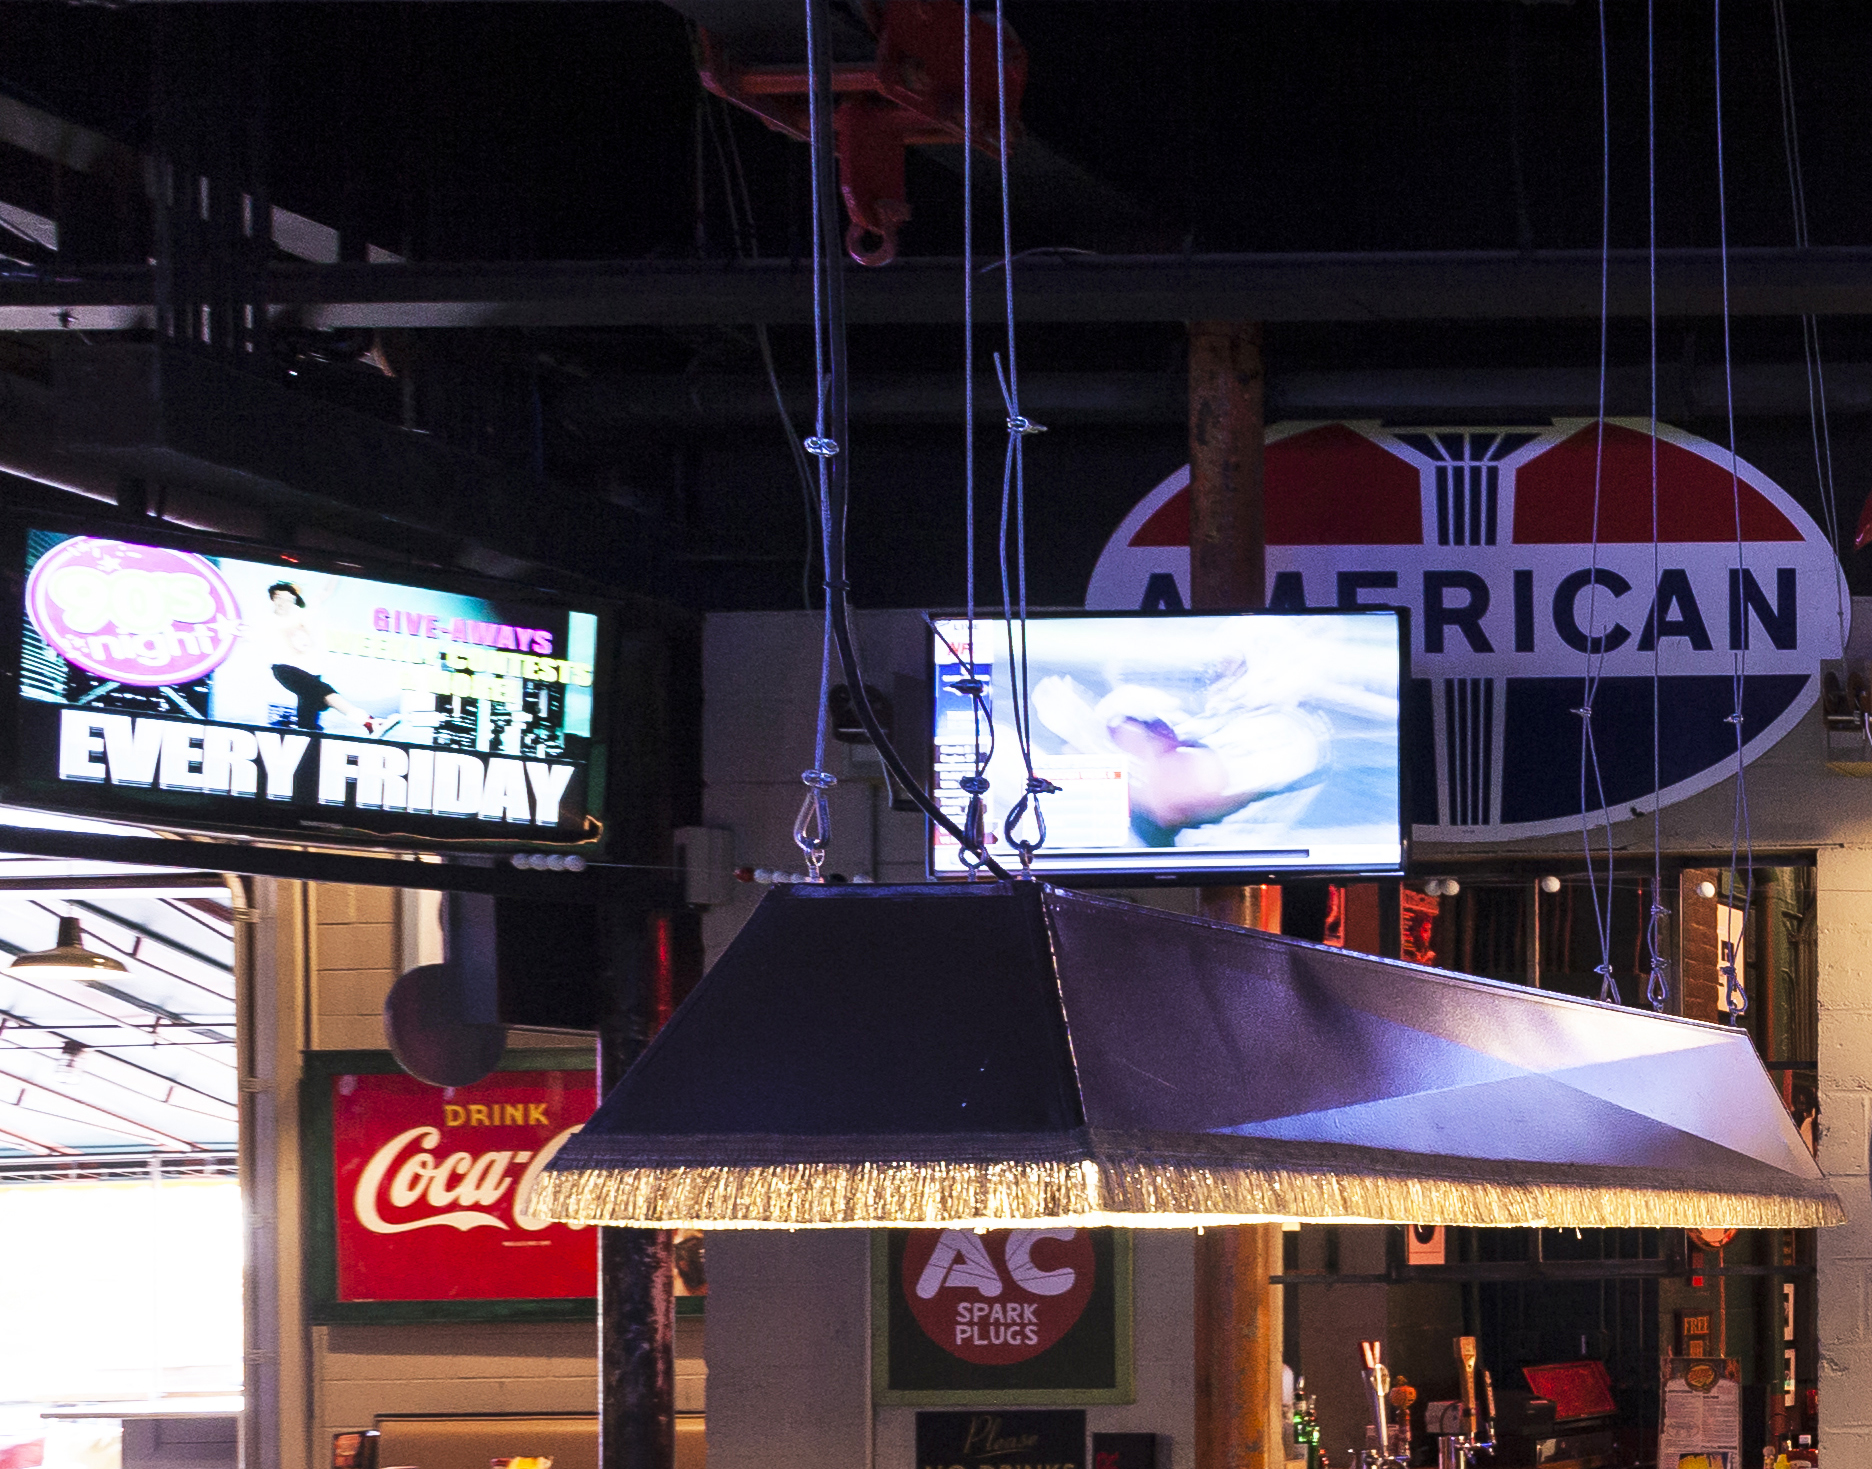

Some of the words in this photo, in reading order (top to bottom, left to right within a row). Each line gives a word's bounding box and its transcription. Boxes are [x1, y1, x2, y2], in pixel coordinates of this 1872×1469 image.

[372, 606, 553, 655] GIVE-AWAYS
[59, 708, 311, 801] EVERY
[318, 737, 576, 827] FRIDAY
[444, 1102, 550, 1127] DRINK
[353, 1123, 588, 1235] Coca-C
[915, 1228, 1077, 1300] AC
[955, 1301, 1039, 1324] SPARK
[954, 1324, 1039, 1346] PLUGS
[963, 1414, 1040, 1454] Please
